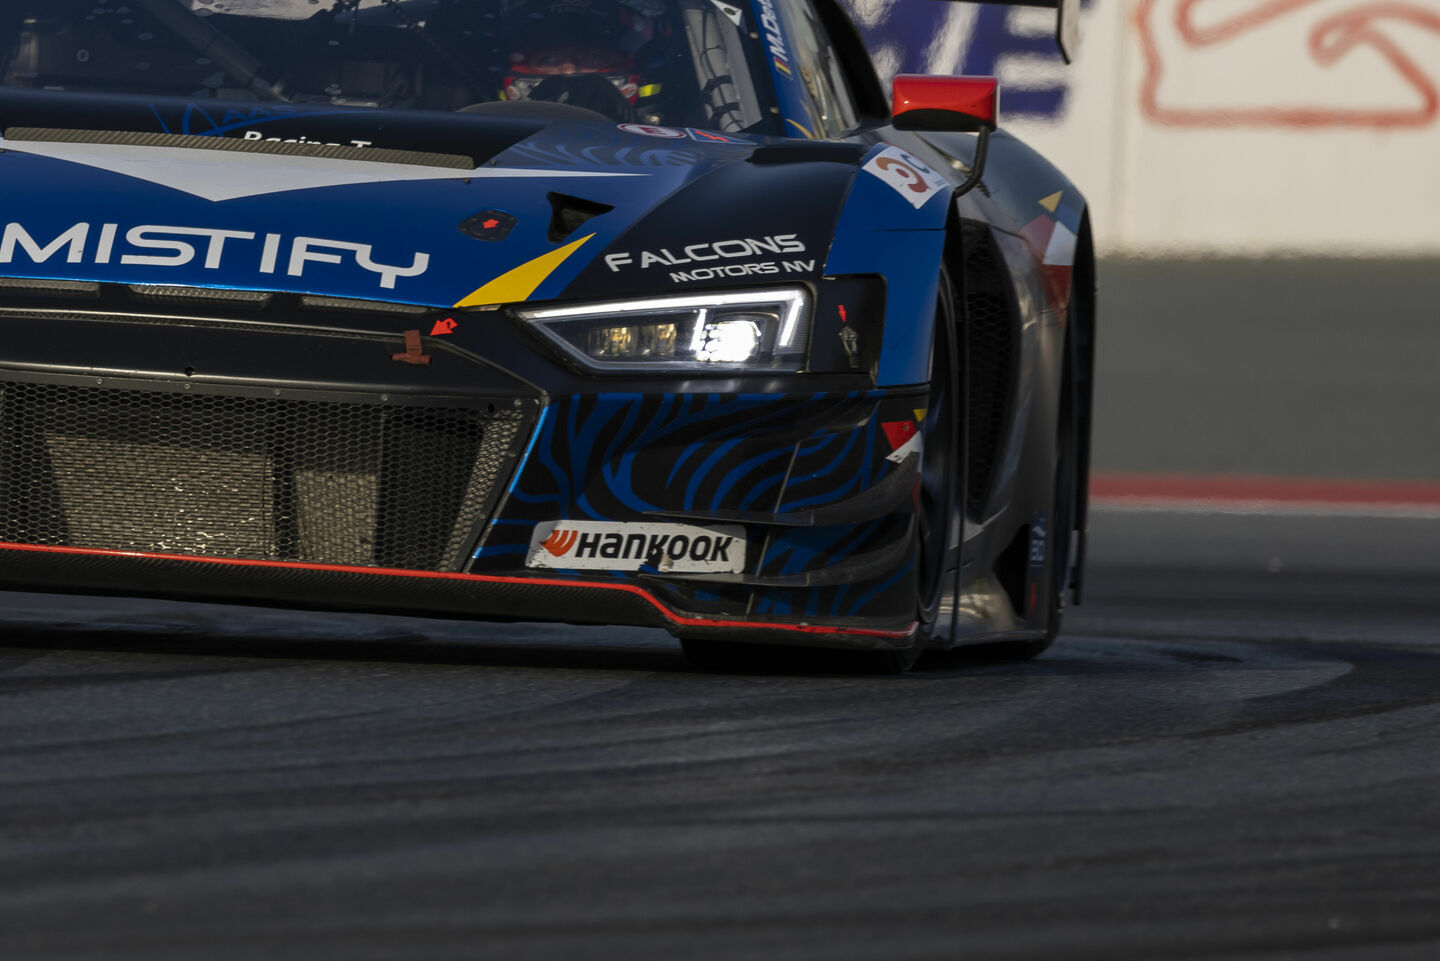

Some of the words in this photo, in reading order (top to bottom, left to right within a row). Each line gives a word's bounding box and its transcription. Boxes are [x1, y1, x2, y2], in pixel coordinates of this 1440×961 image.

[604, 234, 806, 272] FALCONS
[670, 262, 780, 283] MOTORS
[781, 259, 815, 273] NV
